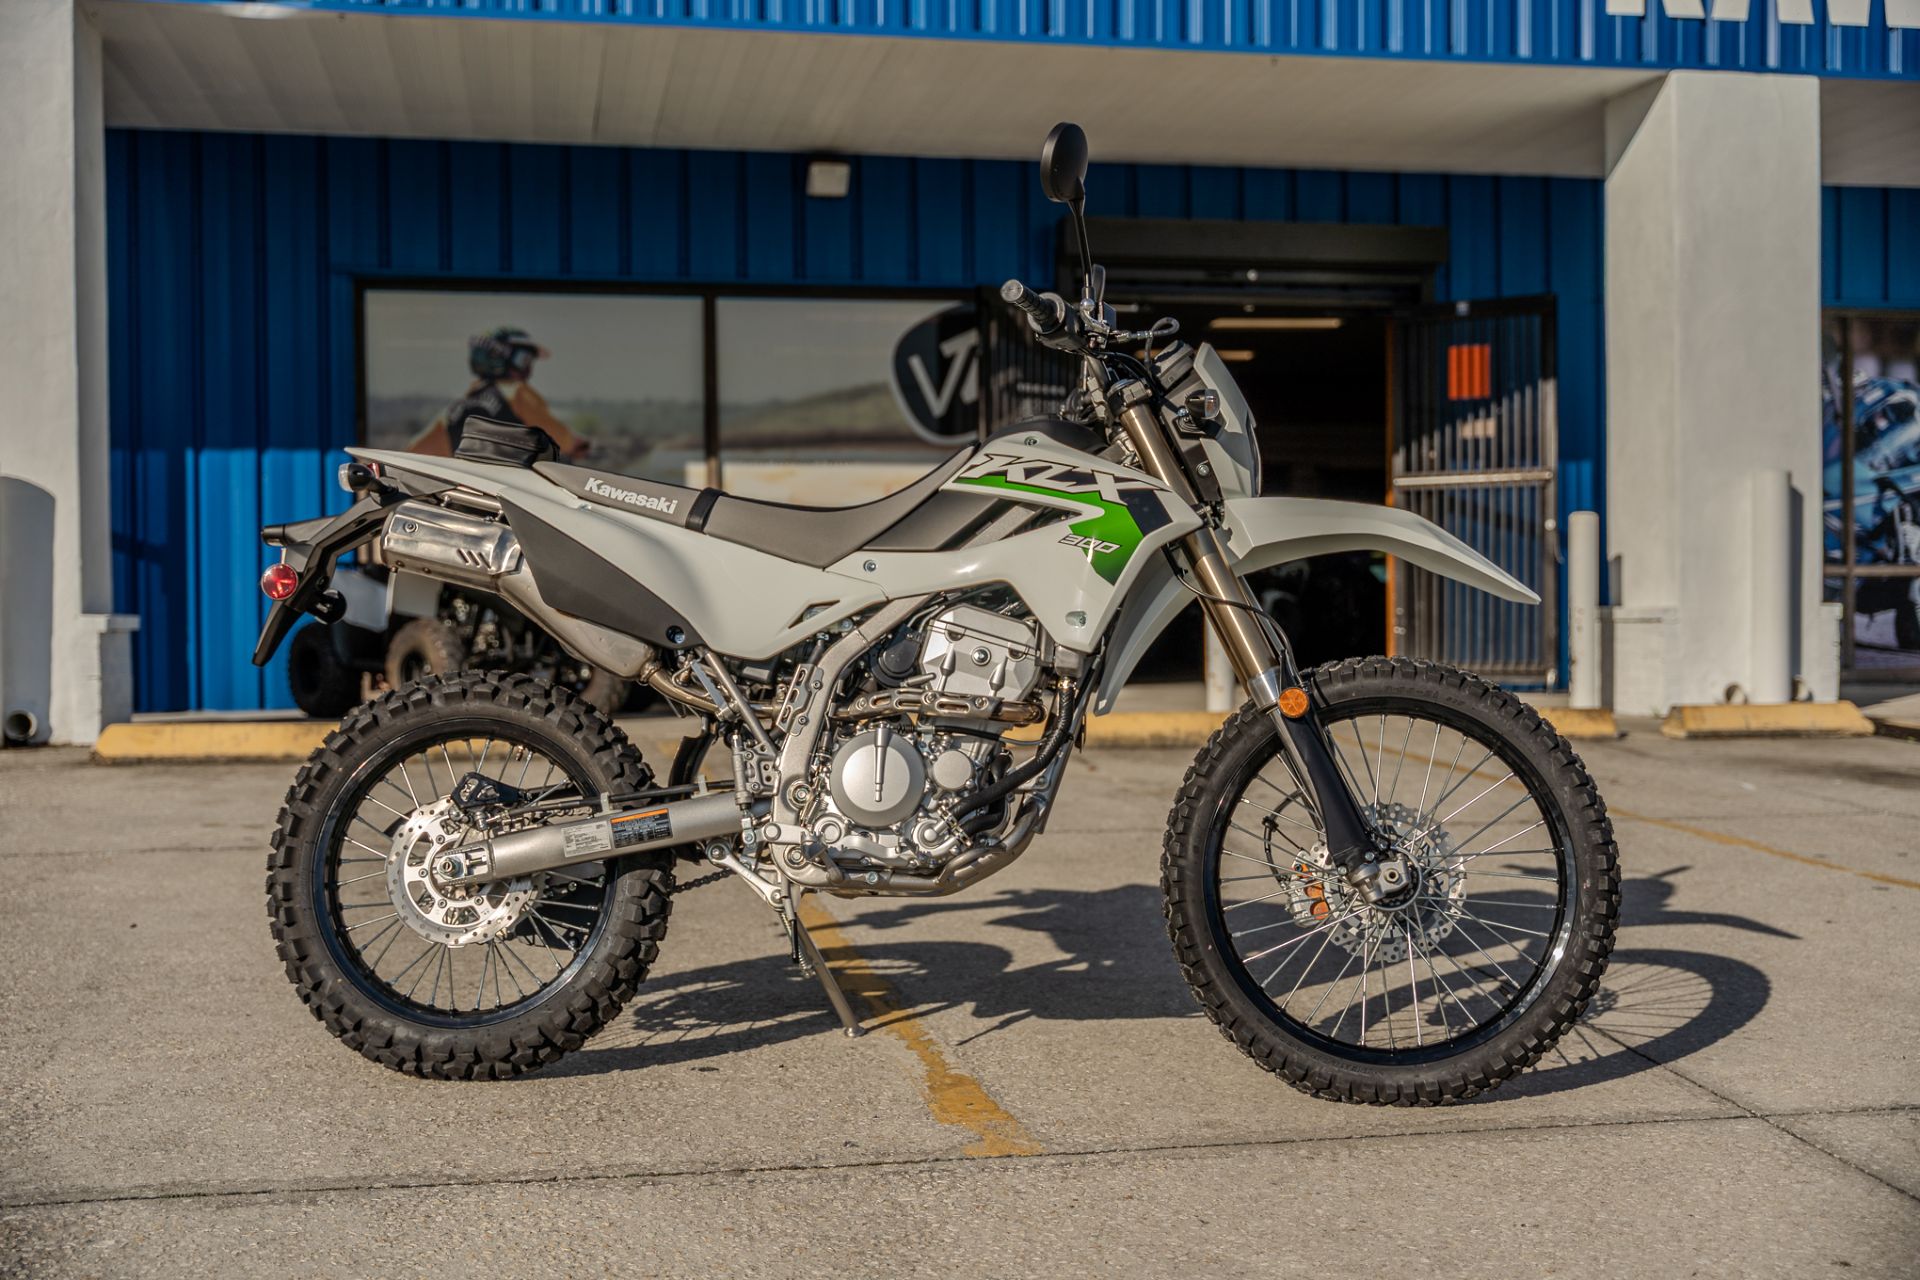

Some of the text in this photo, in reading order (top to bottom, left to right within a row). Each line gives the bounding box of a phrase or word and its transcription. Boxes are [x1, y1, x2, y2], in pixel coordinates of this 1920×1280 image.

[584, 477, 678, 514] Kawasaki
[957, 453, 1172, 506] KLX
[1058, 533, 1121, 554] 300
